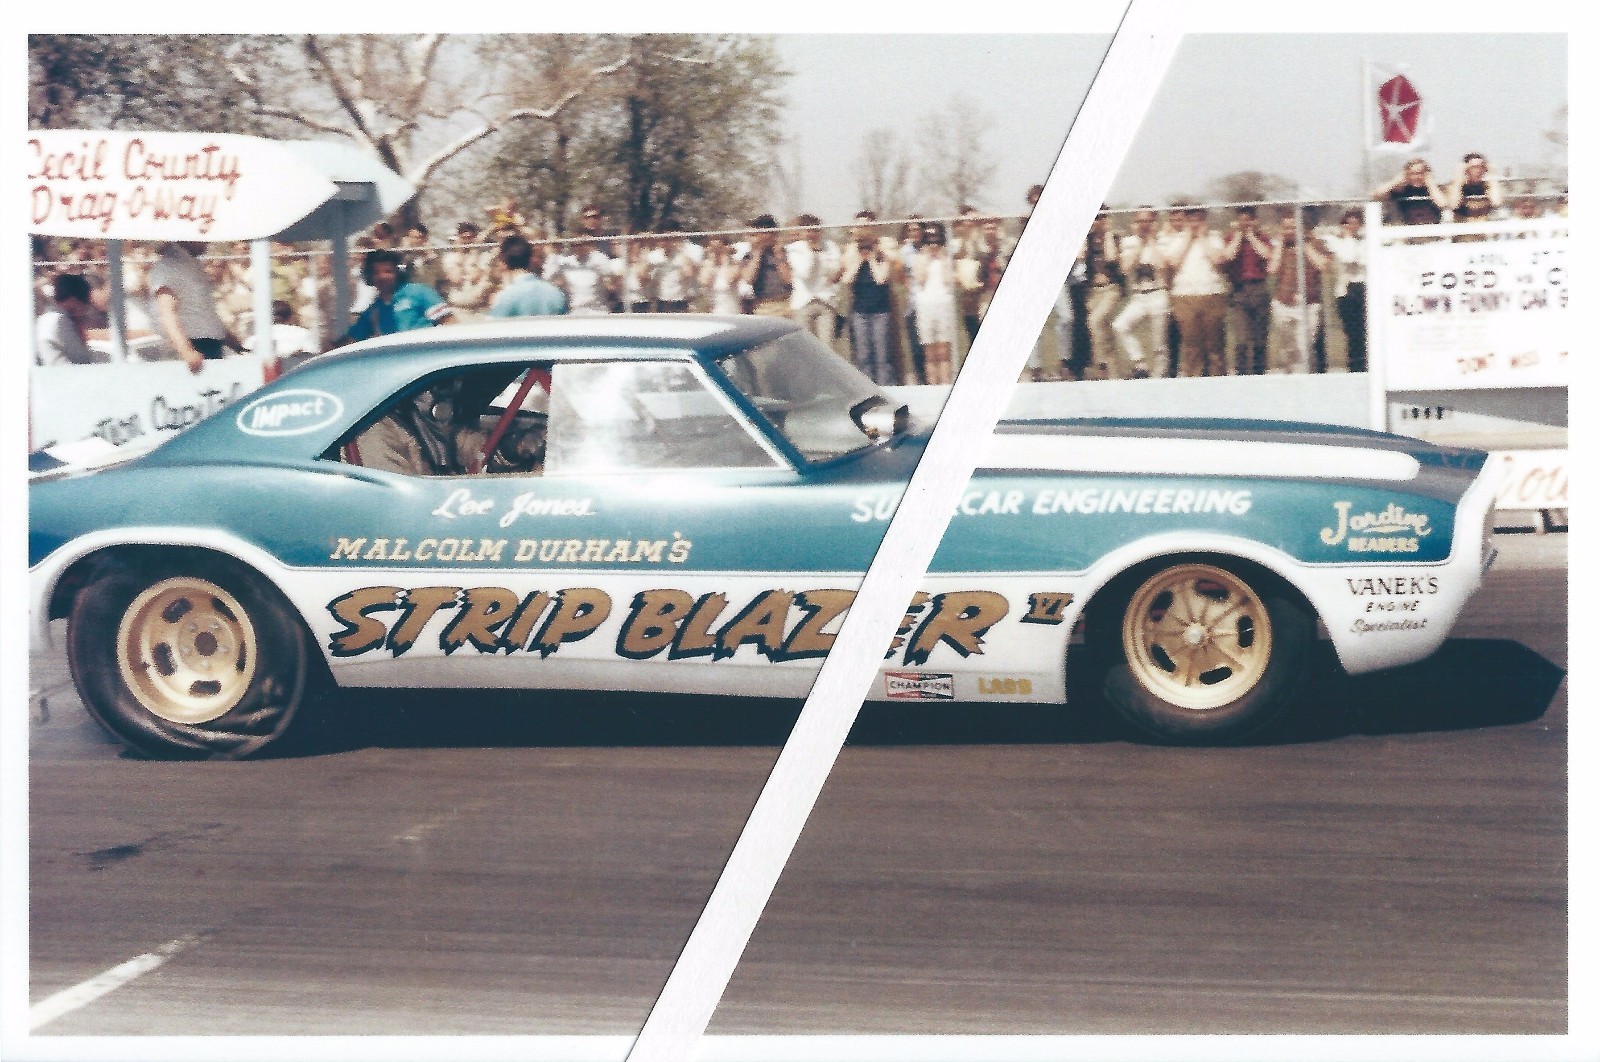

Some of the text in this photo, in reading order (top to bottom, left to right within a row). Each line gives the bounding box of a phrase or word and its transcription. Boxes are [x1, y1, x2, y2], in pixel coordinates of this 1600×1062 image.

[124, 138, 241, 200] County
[1420, 269, 1497, 290] FORD
[432, 488, 495, 519] Lee
[851, 488, 1253, 523] SUCAR ENGINEERING
[1320, 501, 1432, 545] Jardine
[329, 531, 693, 563] MALCOLM DURHAM'S
[1346, 573, 1439, 596] VANEK'S
[326, 585, 613, 660] STRIP
[889, 680, 950, 691] CHAMPION
